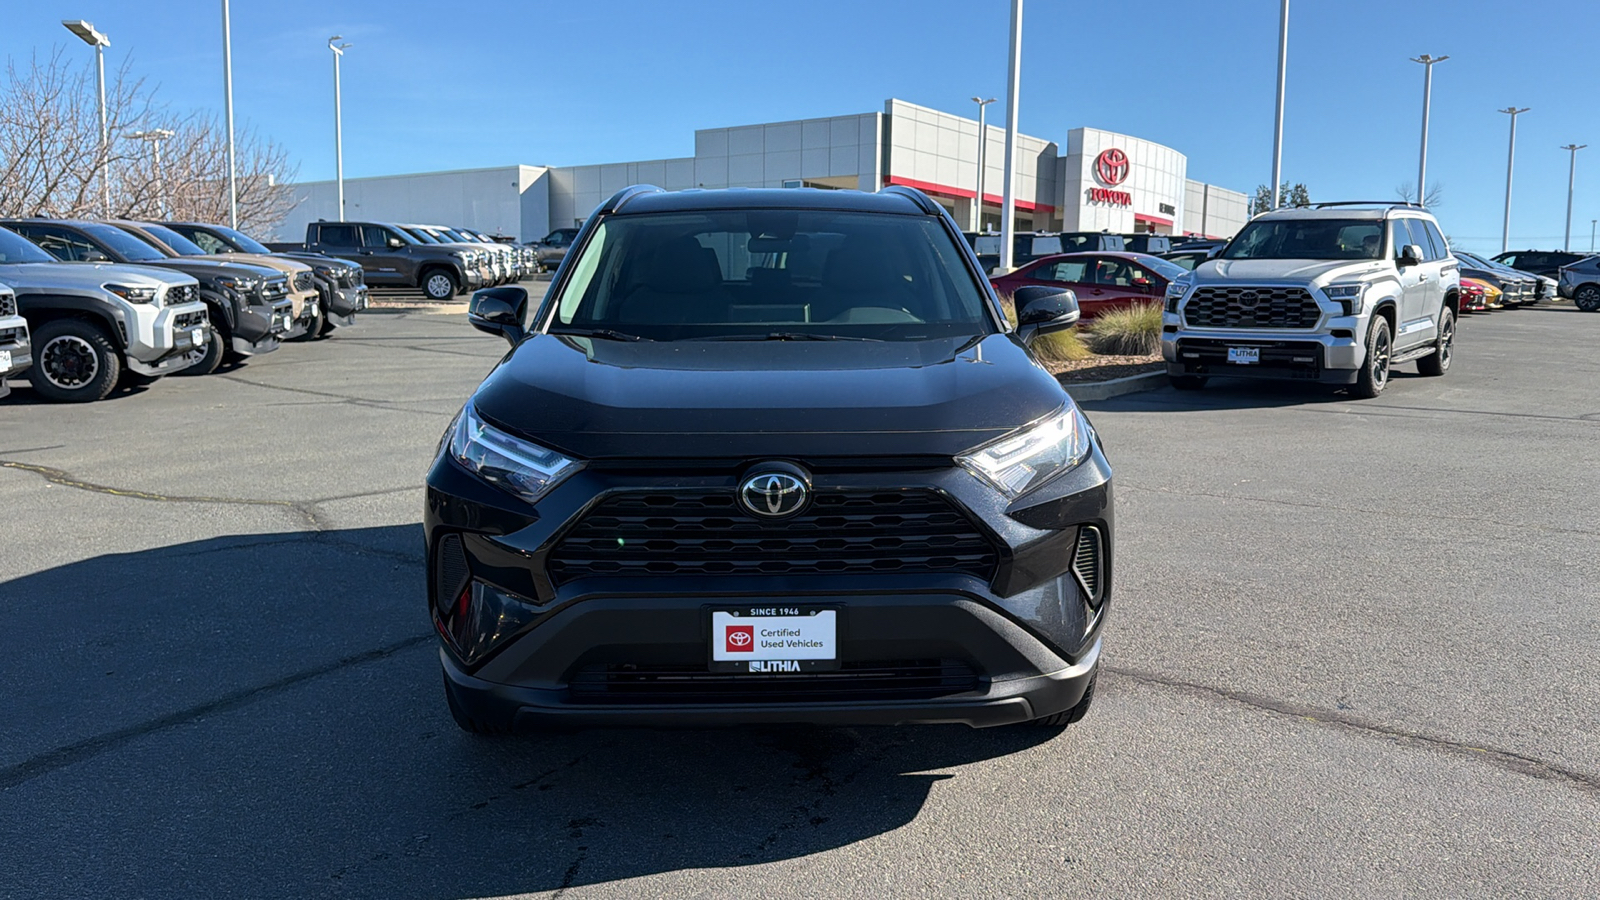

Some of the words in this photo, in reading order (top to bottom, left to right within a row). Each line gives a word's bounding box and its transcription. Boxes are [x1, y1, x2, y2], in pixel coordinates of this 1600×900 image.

[1090, 187, 1132, 206] TOYOTA
[750, 607, 777, 616] SINCE
[779, 607, 799, 616] 1946
[760, 628, 801, 637] Certified
[760, 640, 784, 648] Used
[786, 639, 824, 648] Vehicles
[760, 660, 801, 672] LITHIA
